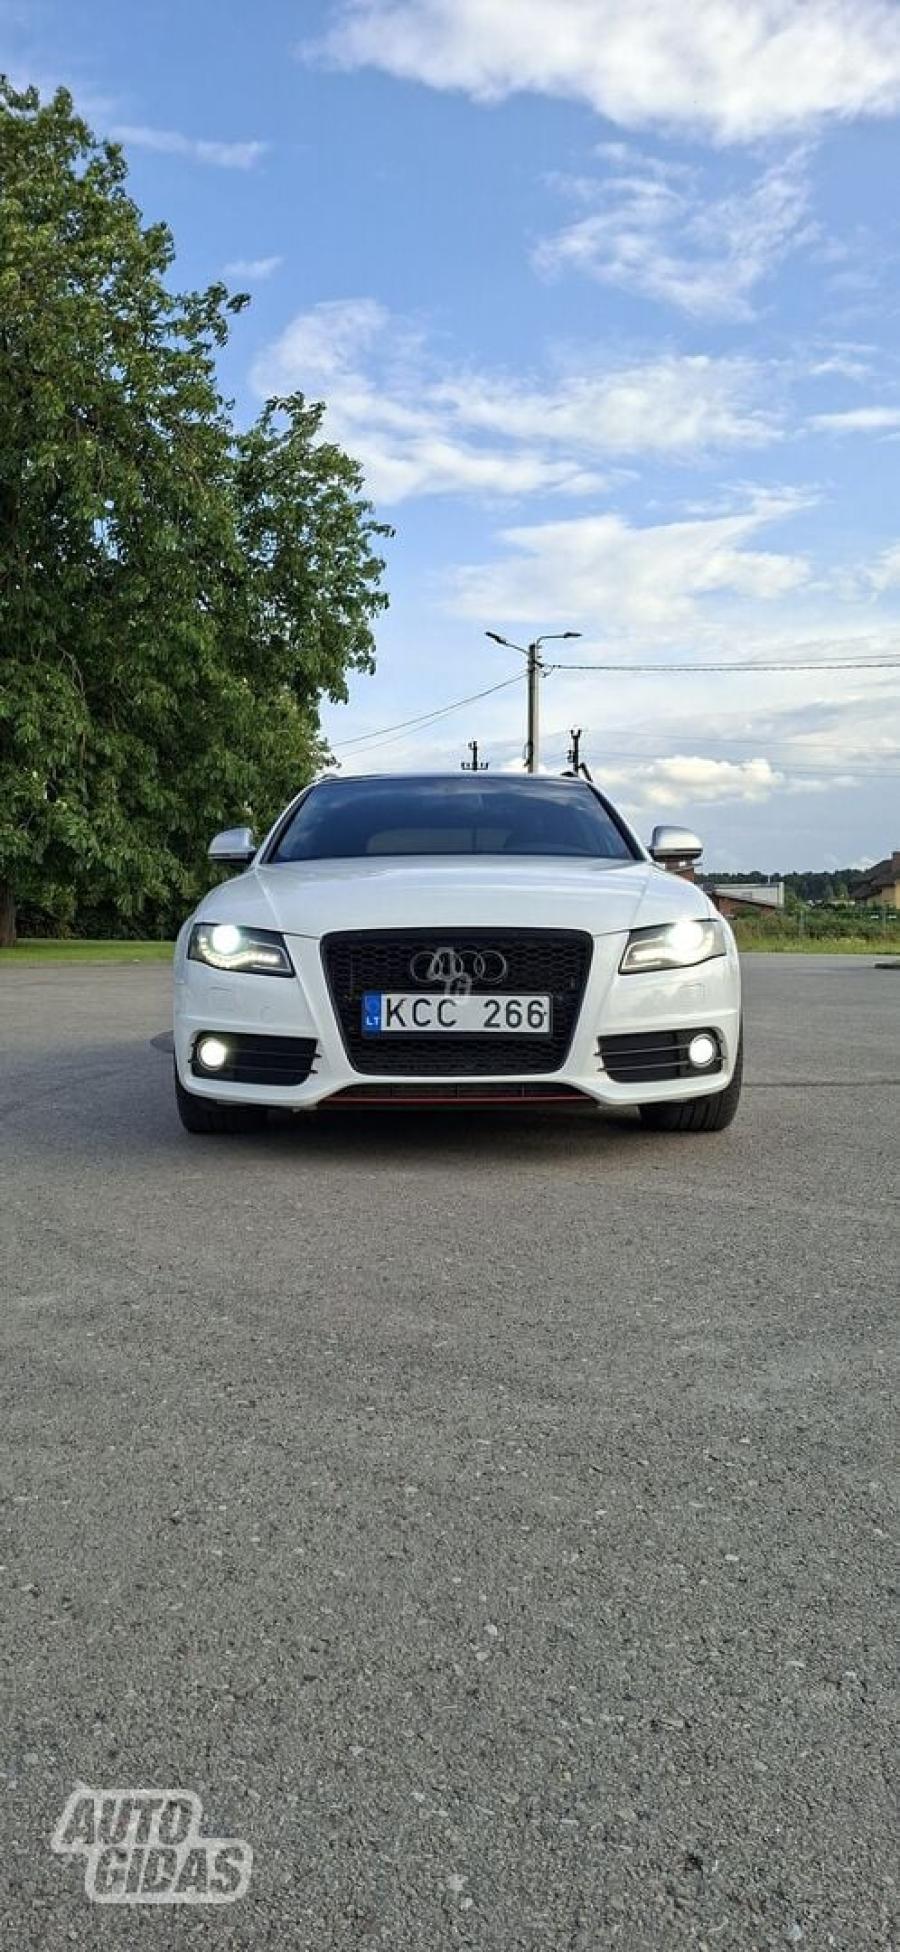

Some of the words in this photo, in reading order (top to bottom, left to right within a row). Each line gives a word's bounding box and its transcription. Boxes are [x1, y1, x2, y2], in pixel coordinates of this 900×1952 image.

[366, 1016, 379, 1026] LT
[385, 997, 457, 1028] KCC
[483, 999, 545, 1029] 266
